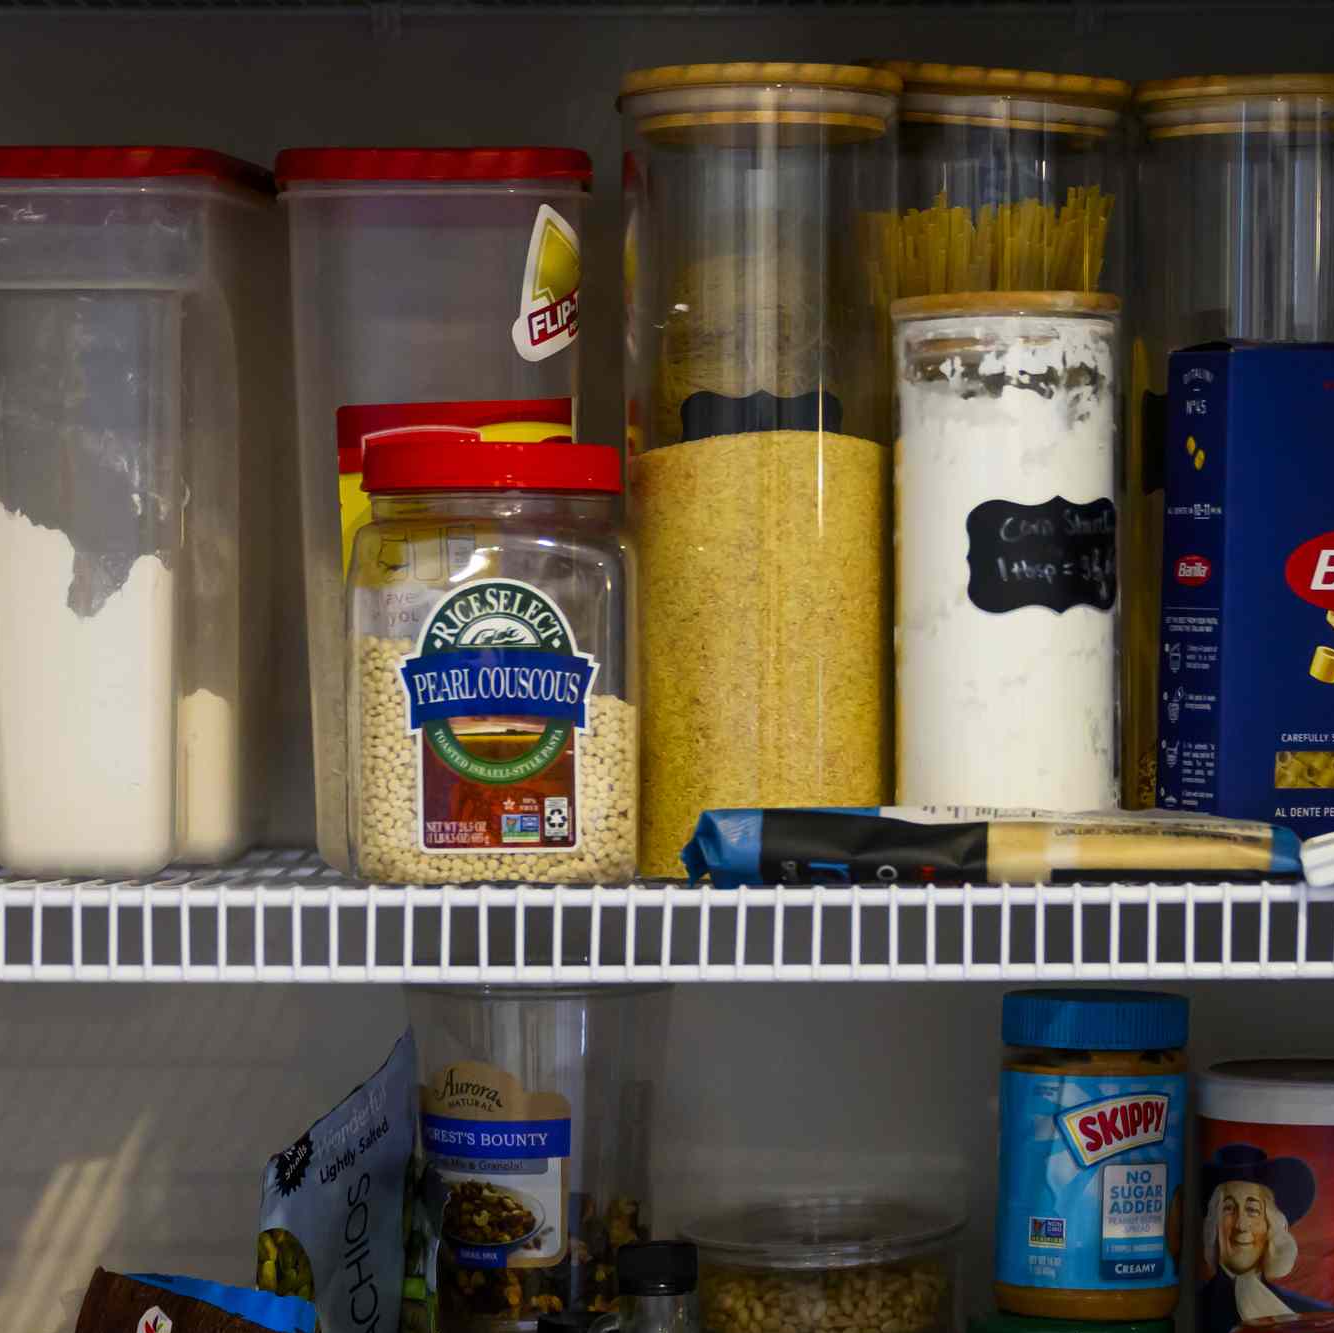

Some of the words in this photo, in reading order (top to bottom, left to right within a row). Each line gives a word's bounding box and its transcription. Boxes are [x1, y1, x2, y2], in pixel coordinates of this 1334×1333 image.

[1177, 560, 1210, 578] Barilla
[412, 667, 477, 705] PEARL
[477, 666, 581, 704] COUSCOUS
[1280, 732, 1329, 743] CAREFULLY
[1274, 805, 1287, 818] AL
[1289, 805, 1320, 818] DENTE
[435, 1068, 504, 1108] Aurora
[1078, 1101, 1165, 1152] SKIPPY
[480, 1130, 548, 1147] BOUNTY
[319, 1147, 356, 1186] Lightly
[358, 1117, 390, 1155] Salted
[1126, 1170, 1152, 1184] NO
[1110, 1184, 1164, 1200] SUGAR
[1110, 1200, 1163, 1214] ADDED
[1114, 1263, 1157, 1275] CREAMY
